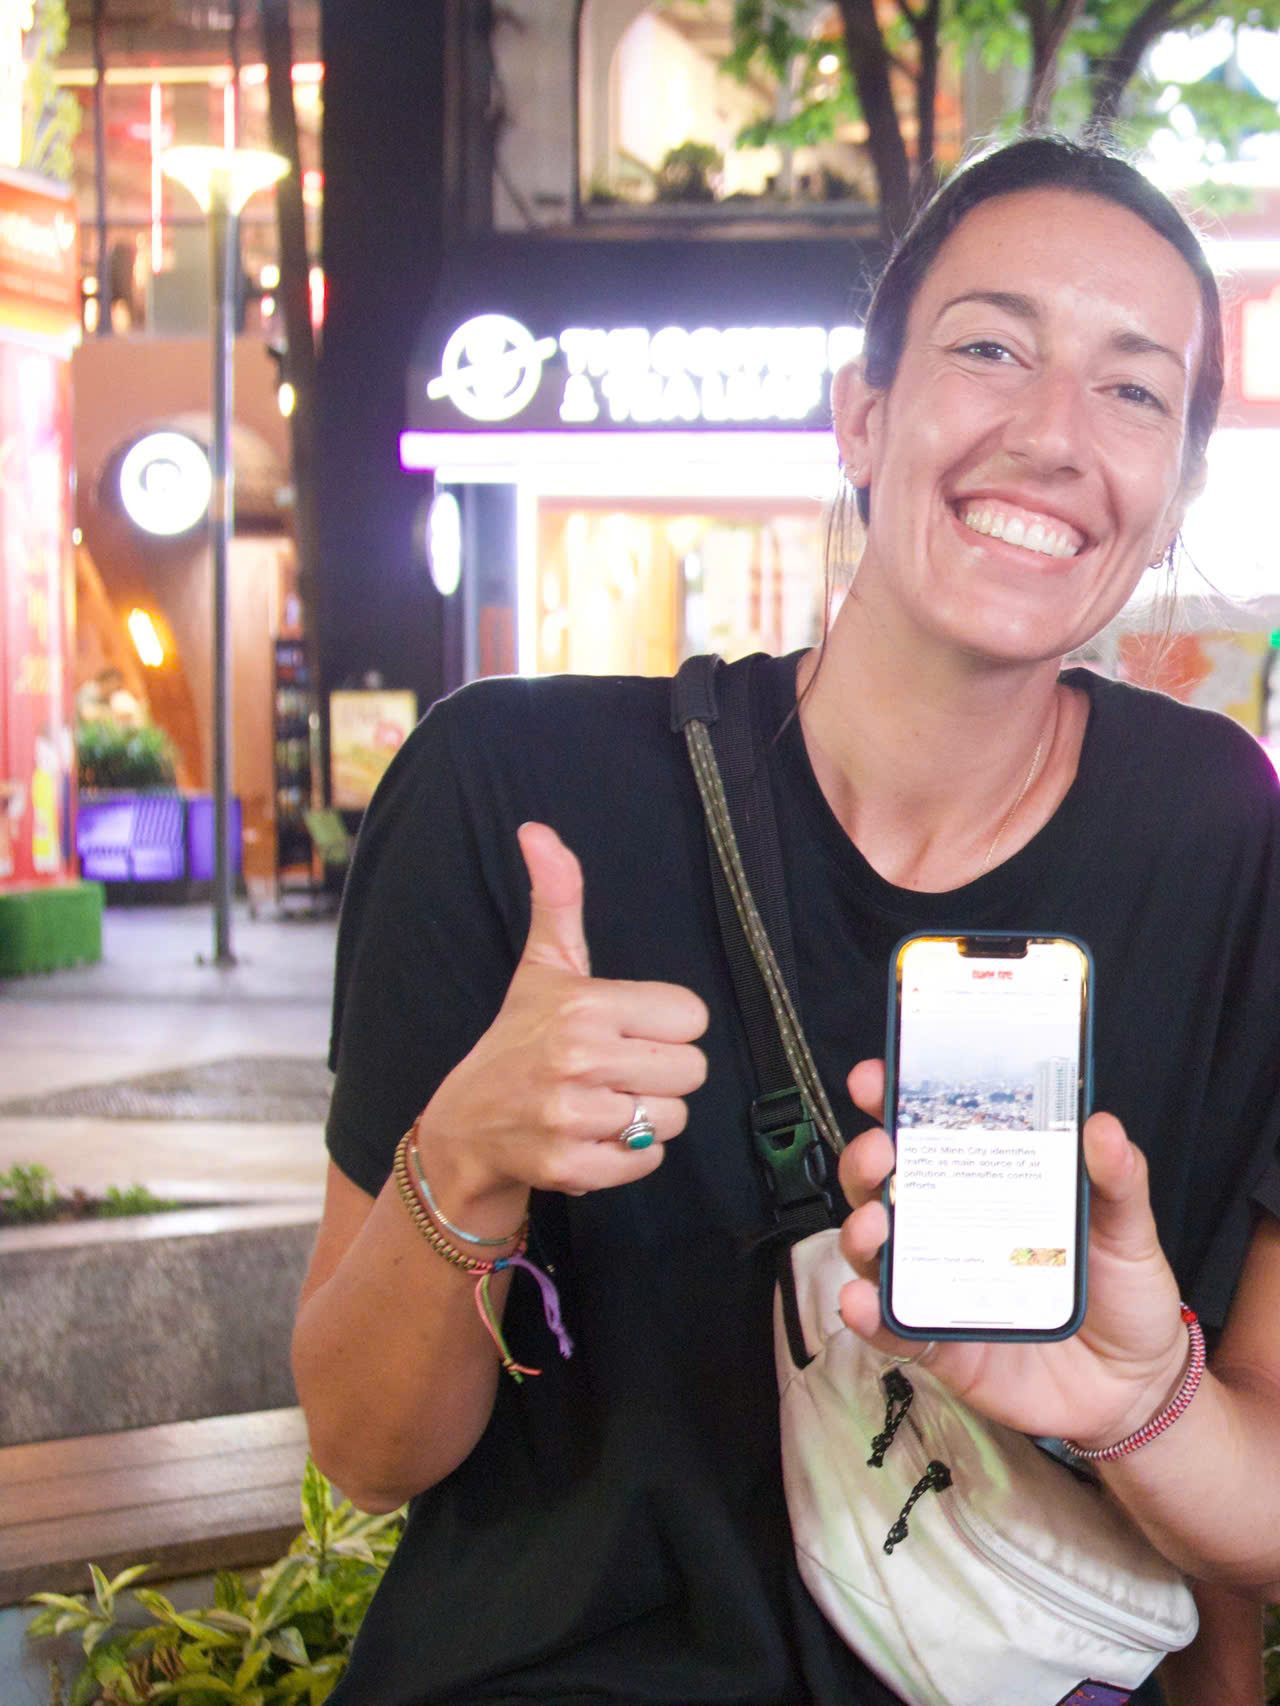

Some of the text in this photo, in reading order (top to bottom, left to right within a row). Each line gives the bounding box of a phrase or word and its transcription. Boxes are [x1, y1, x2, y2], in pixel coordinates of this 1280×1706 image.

[904, 1145, 1036, 1156] Ho Chi Minh City identifies
[904, 1158, 934, 1167] traffic
[951, 1159, 975, 1167] main
[980, 1160, 1012, 1168] source
[1016, 1159, 1026, 1168] of
[952, 1170, 1004, 1179] intensifies
[1007, 1171, 1042, 1180] control
[904, 1181, 936, 1190] efforts
